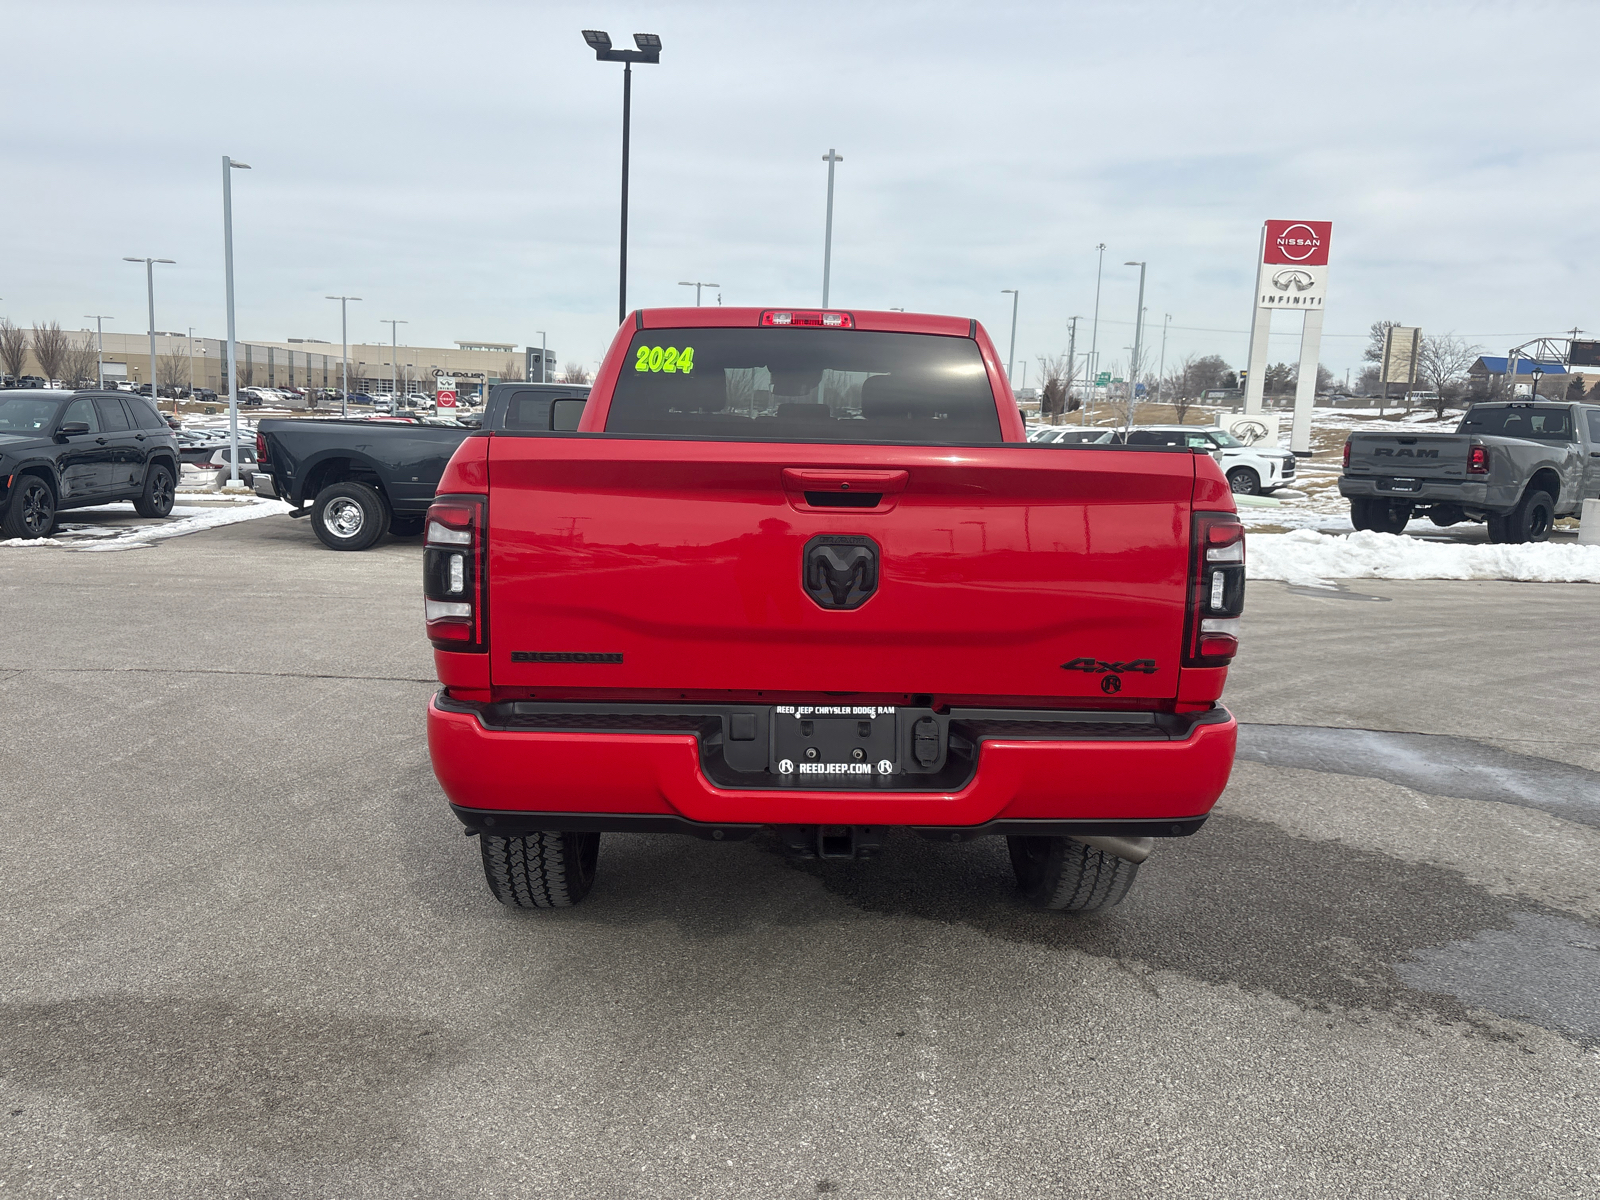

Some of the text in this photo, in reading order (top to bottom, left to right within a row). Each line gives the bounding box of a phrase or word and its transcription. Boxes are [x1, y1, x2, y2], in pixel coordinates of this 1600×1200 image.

[1277, 238, 1320, 246] NISSAN
[1261, 295, 1322, 305] INFINITI
[635, 345, 694, 374] 2024
[1373, 447, 1439, 459] RAM
[819, 536, 868, 544] RAM
[1060, 657, 1160, 674] 4x4
[776, 706, 895, 714] REED JEEP CHRYSLER DODGE RAM
[799, 763, 872, 774] REEDJEEP.COM
